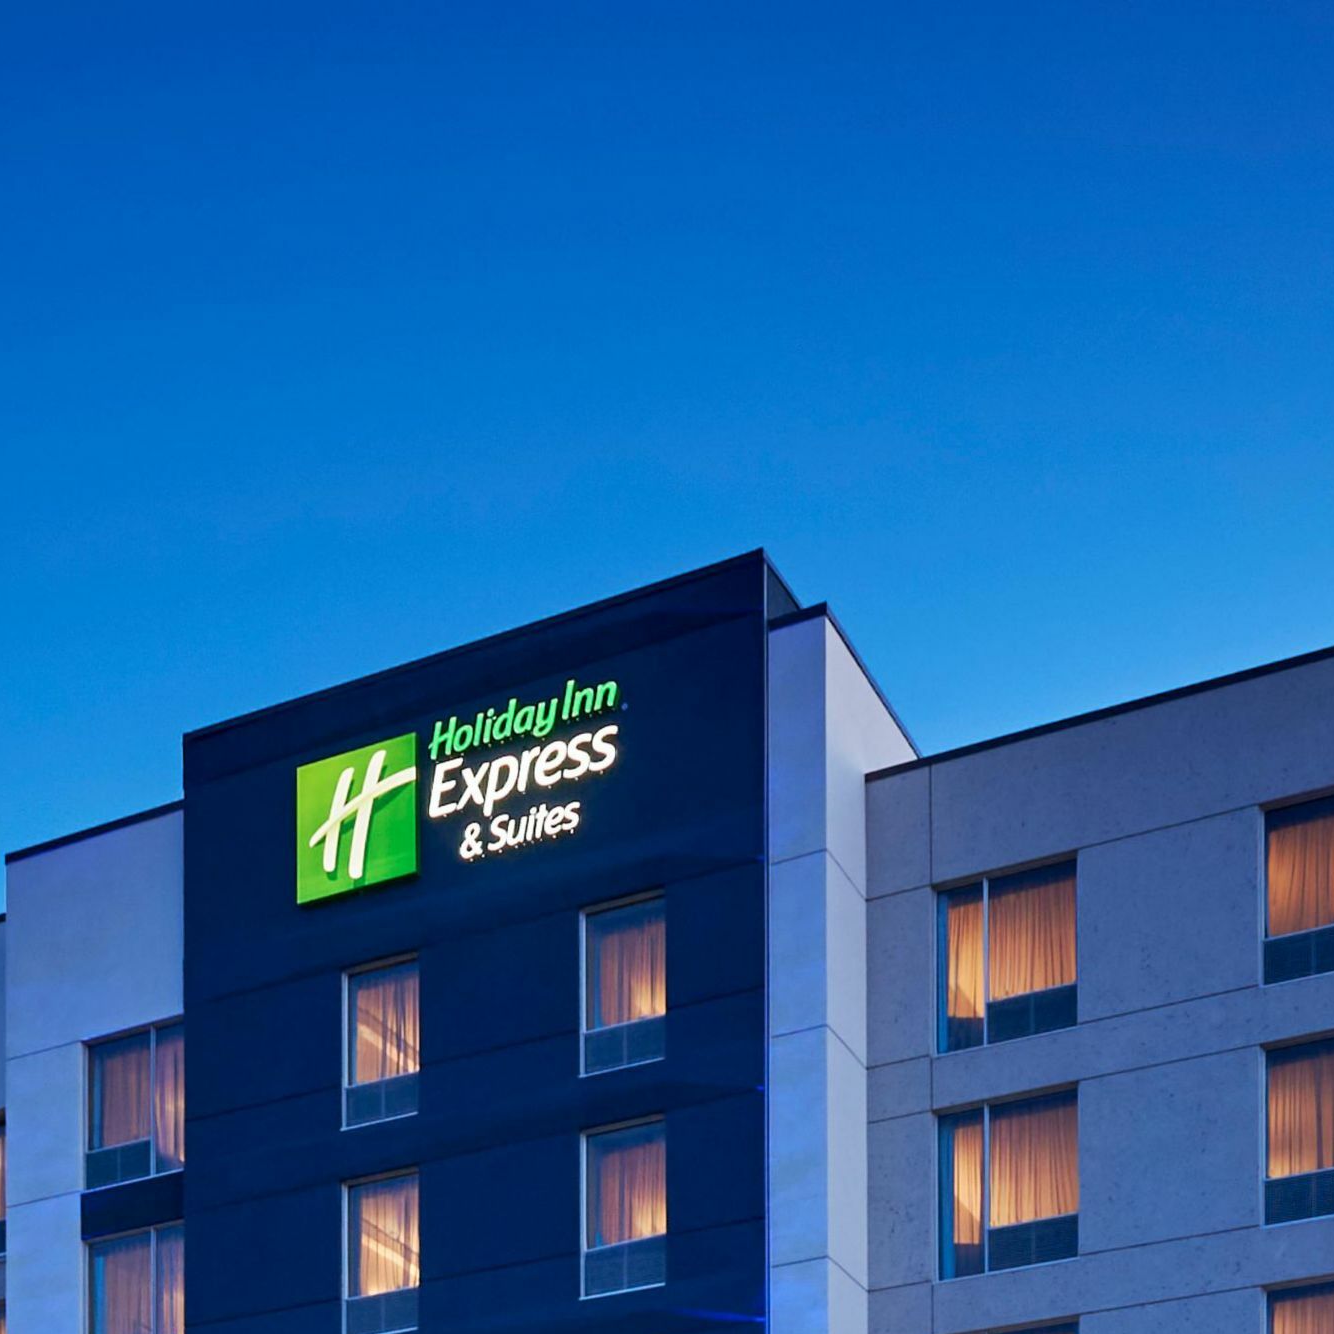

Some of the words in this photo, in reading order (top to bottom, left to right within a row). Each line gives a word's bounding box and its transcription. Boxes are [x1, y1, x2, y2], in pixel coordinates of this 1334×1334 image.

[428, 698, 558, 760] Holiday
[561, 679, 618, 721] Inn
[309, 749, 416, 880] H
[427, 725, 618, 818] Express
[459, 822, 483, 859] &
[487, 801, 581, 851] Suites
